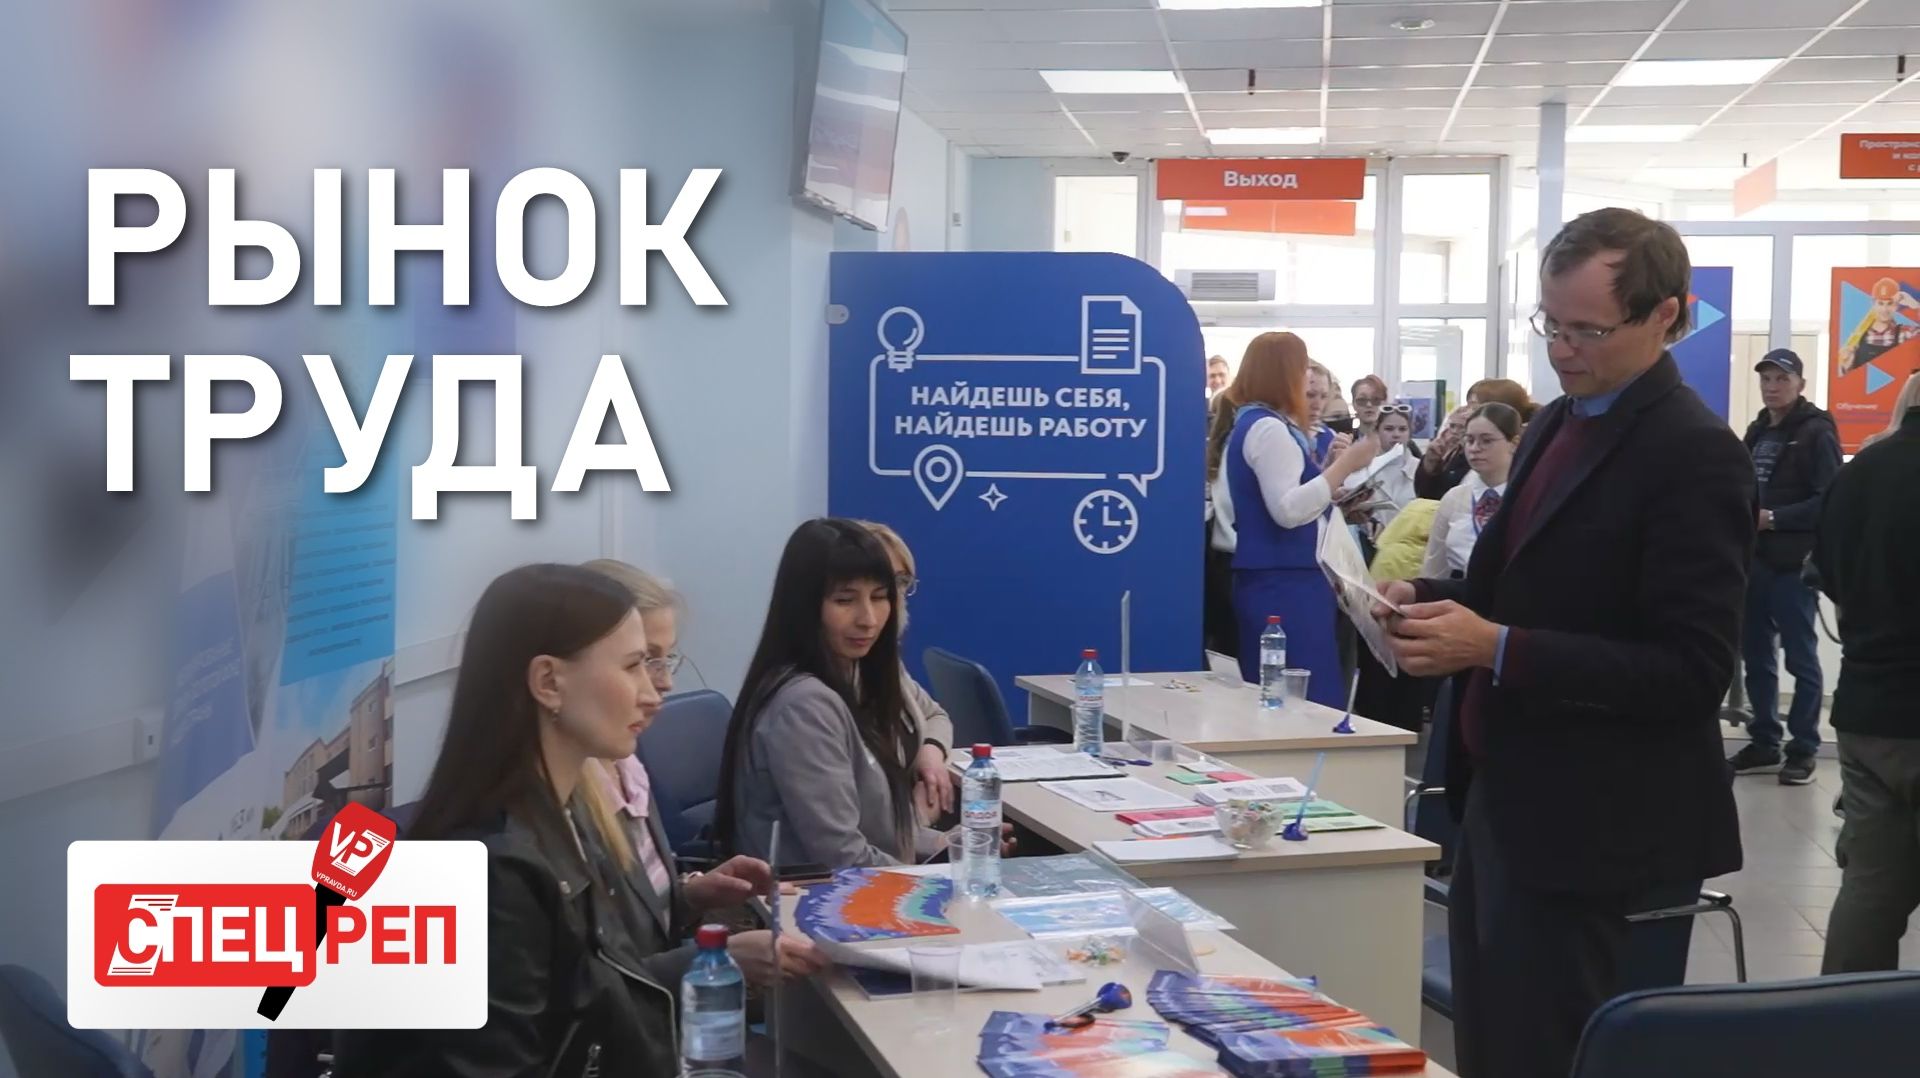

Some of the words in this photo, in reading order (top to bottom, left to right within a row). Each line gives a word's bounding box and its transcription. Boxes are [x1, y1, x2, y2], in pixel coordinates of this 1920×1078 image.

[1223, 170, 1299, 189] Выход
[911, 381, 1049, 409] НАЙДЕШЬ
[1055, 387, 1130, 411] СЕБЯ,
[895, 411, 1033, 439] НАЙДЕШЬ
[1039, 416, 1147, 439] РАБОТУ
